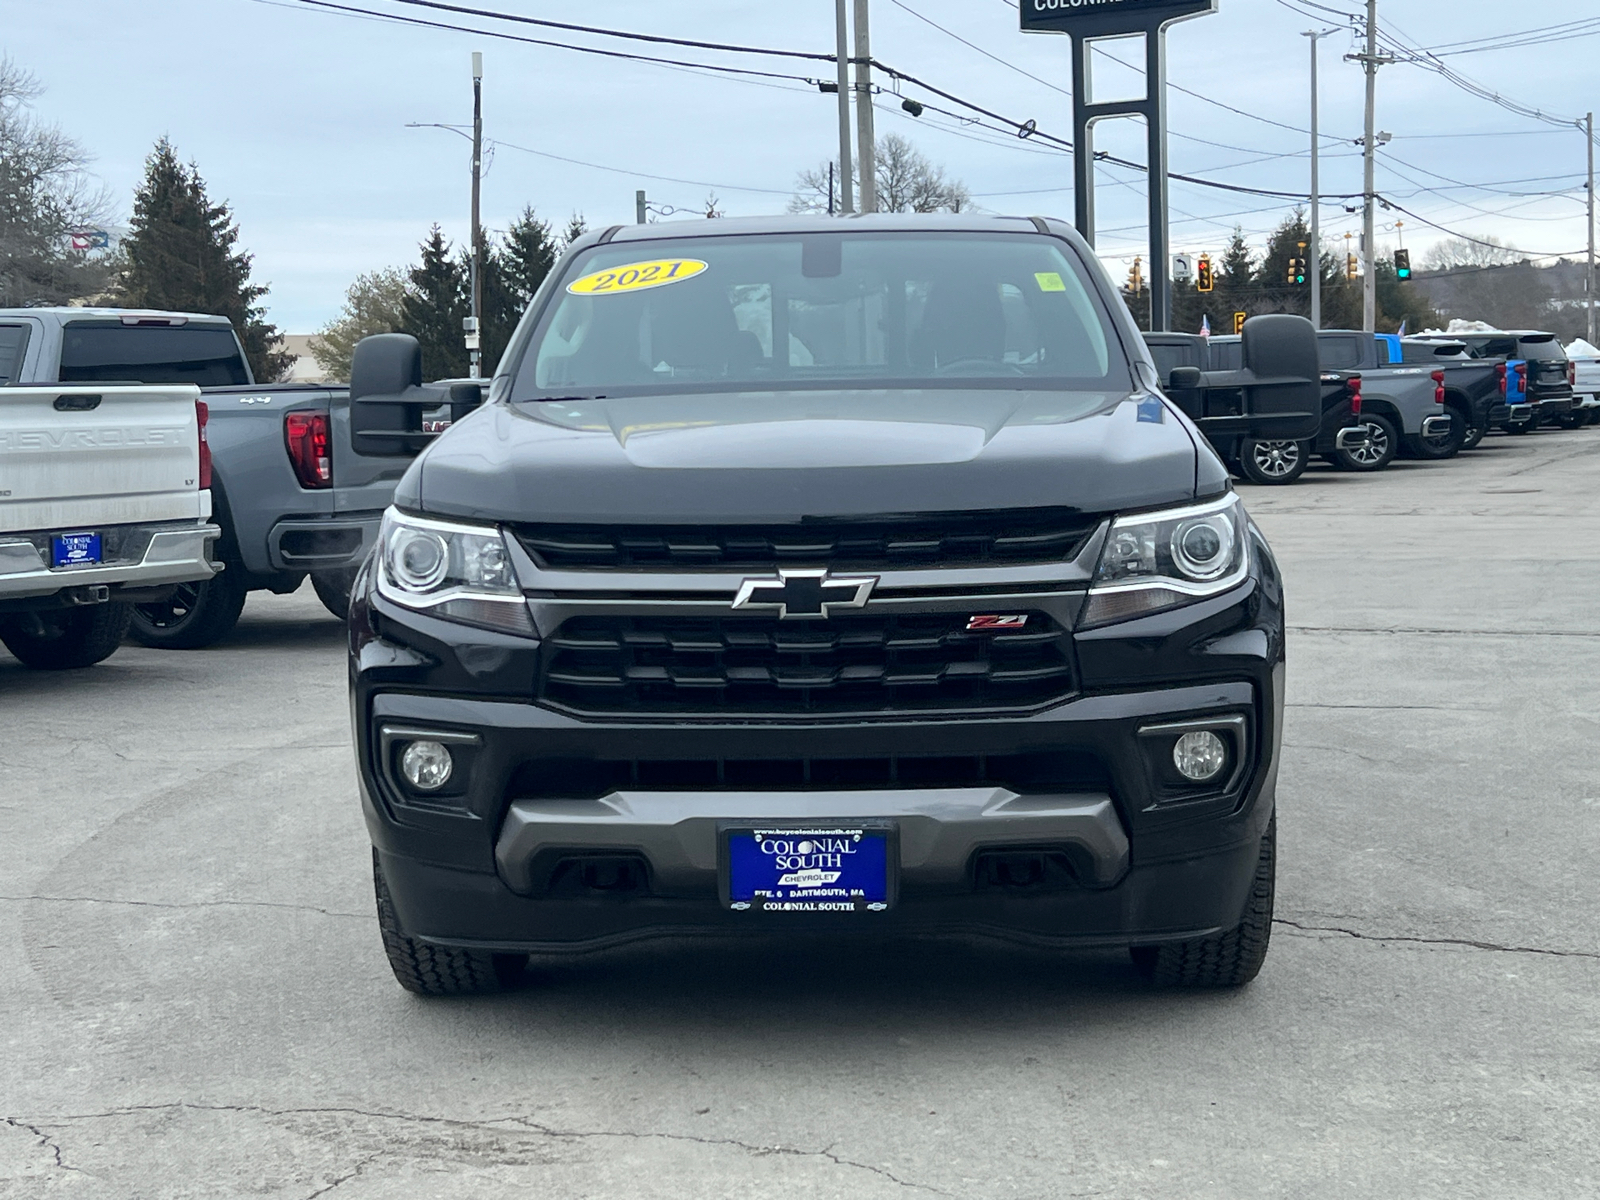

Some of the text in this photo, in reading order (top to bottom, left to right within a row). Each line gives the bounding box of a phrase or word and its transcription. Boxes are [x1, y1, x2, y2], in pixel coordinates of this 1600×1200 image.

[591, 261, 683, 291] 2021
[0, 426, 186, 450] HEVROLET
[761, 838, 857, 855] COLONIAL
[776, 853, 841, 870] SOUTH
[784, 873, 835, 883] CHEVROLET
[790, 889, 849, 897] DARTMOUTH,
[763, 902, 855, 911] COLONIAL SOUTH
